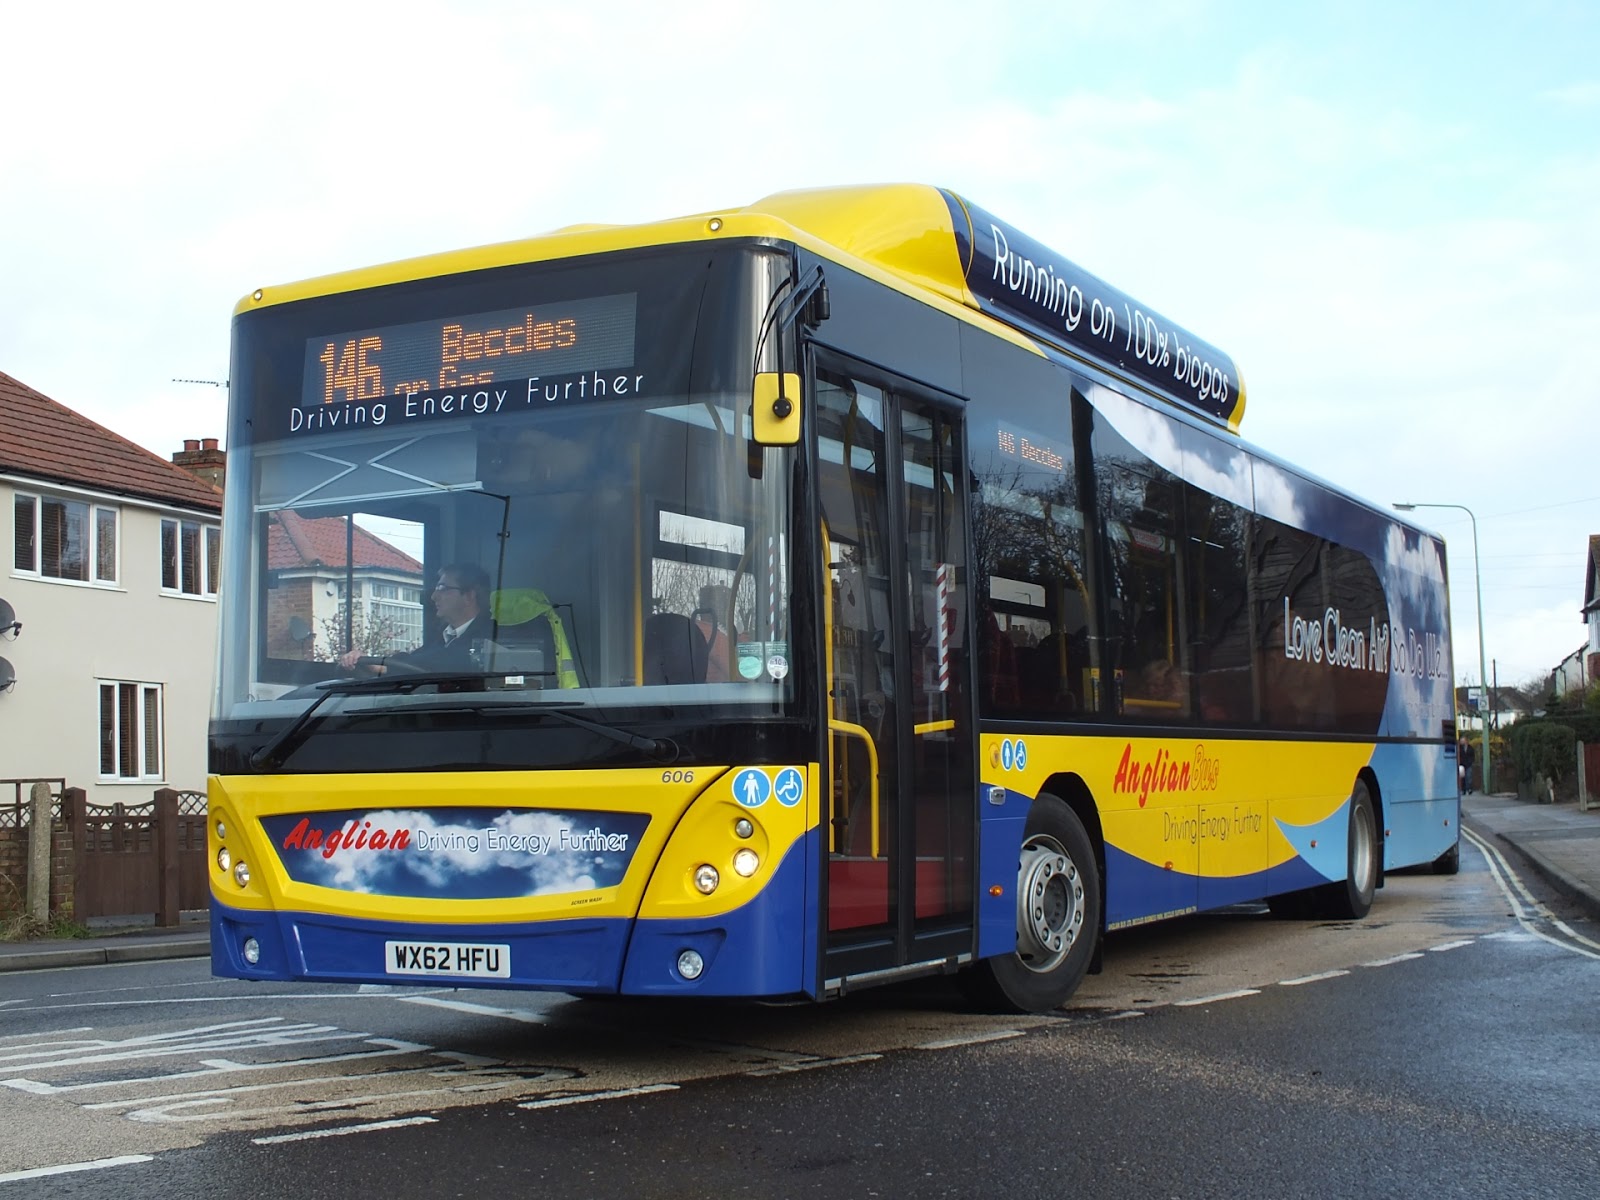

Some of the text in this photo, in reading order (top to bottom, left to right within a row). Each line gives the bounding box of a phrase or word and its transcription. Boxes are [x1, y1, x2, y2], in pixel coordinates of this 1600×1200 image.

[990, 224, 1229, 403] Running on 100% biogas
[320, 314, 576, 404] 146 Beccles
[290, 371, 644, 432] Driving Energy Further
[1284, 596, 1323, 664] Love
[1323, 607, 1366, 670] Clean
[1393, 627, 1406, 674] So
[1409, 627, 1424, 680] Do
[661, 770, 695, 784] 606
[283, 817, 629, 859] Anglian Driving Energy Further
[1164, 806, 1262, 845] Driving Energy Further
[395, 945, 499, 972] WX62 HFU
